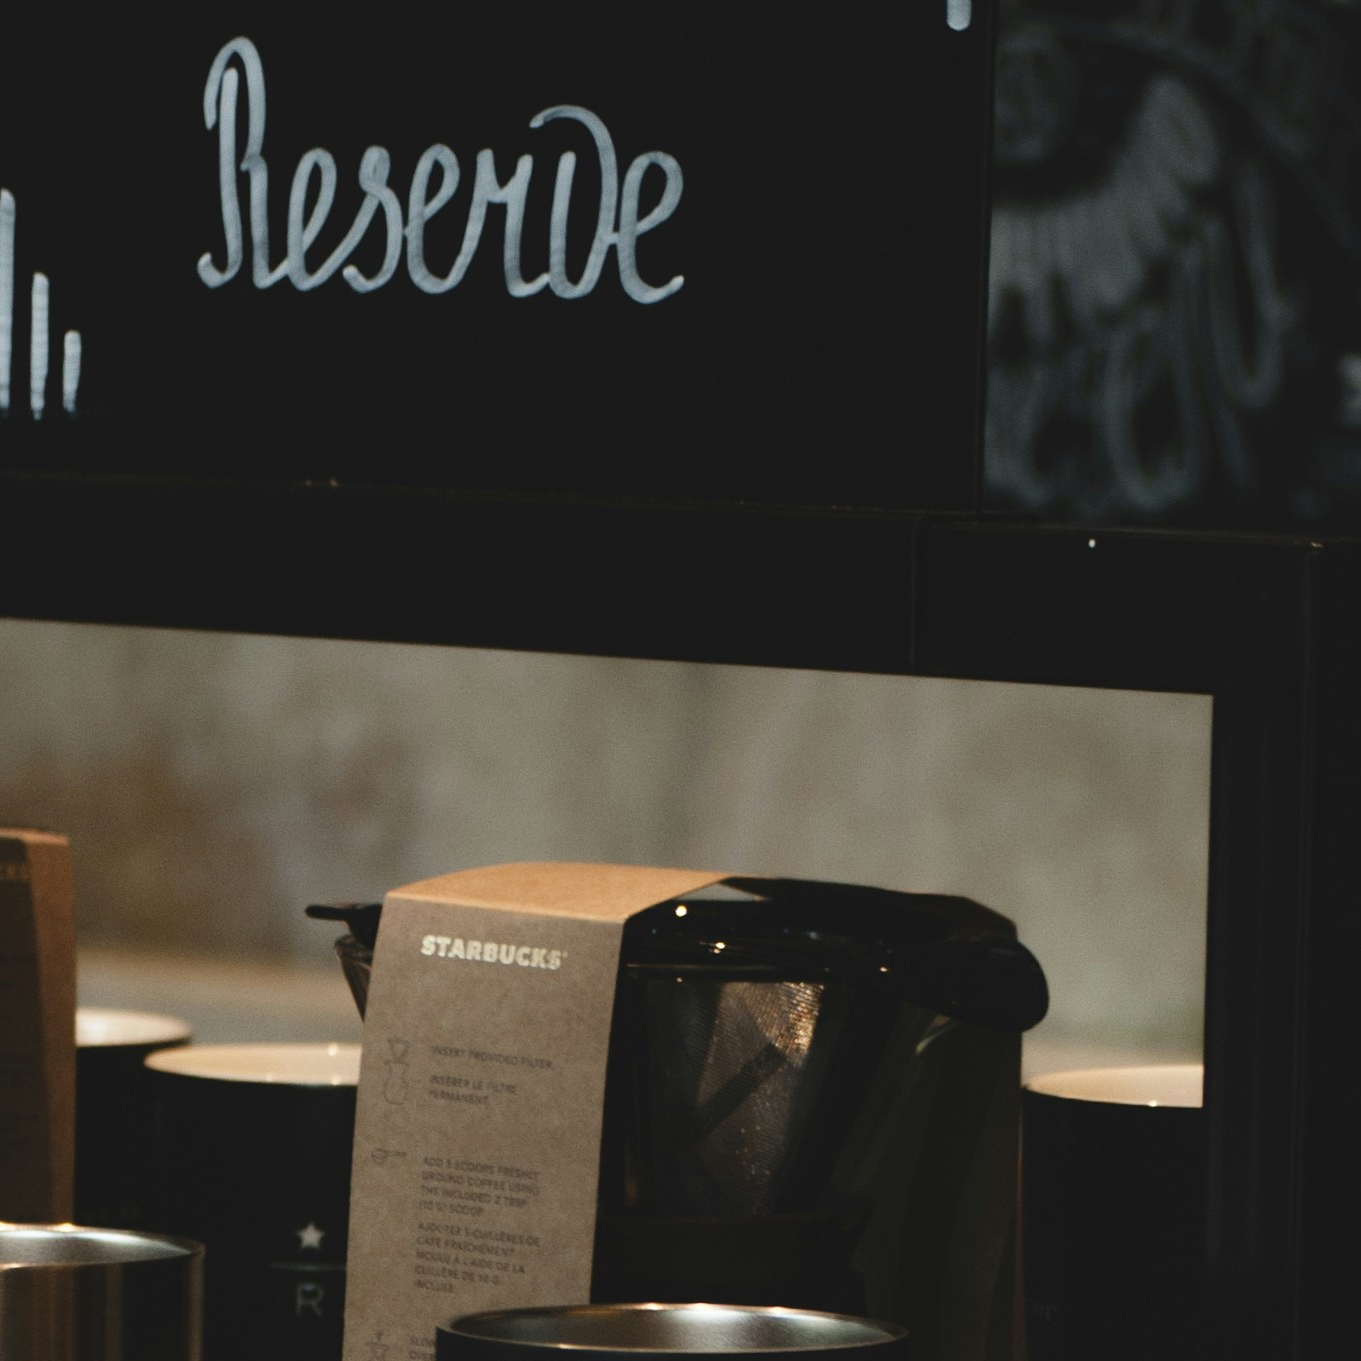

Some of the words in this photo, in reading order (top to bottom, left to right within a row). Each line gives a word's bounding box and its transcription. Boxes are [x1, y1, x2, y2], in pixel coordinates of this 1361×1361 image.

[196, 35, 685, 304] Reserve
[420, 934, 562, 970] STARBUCKS
[295, 1282, 325, 1318] R
